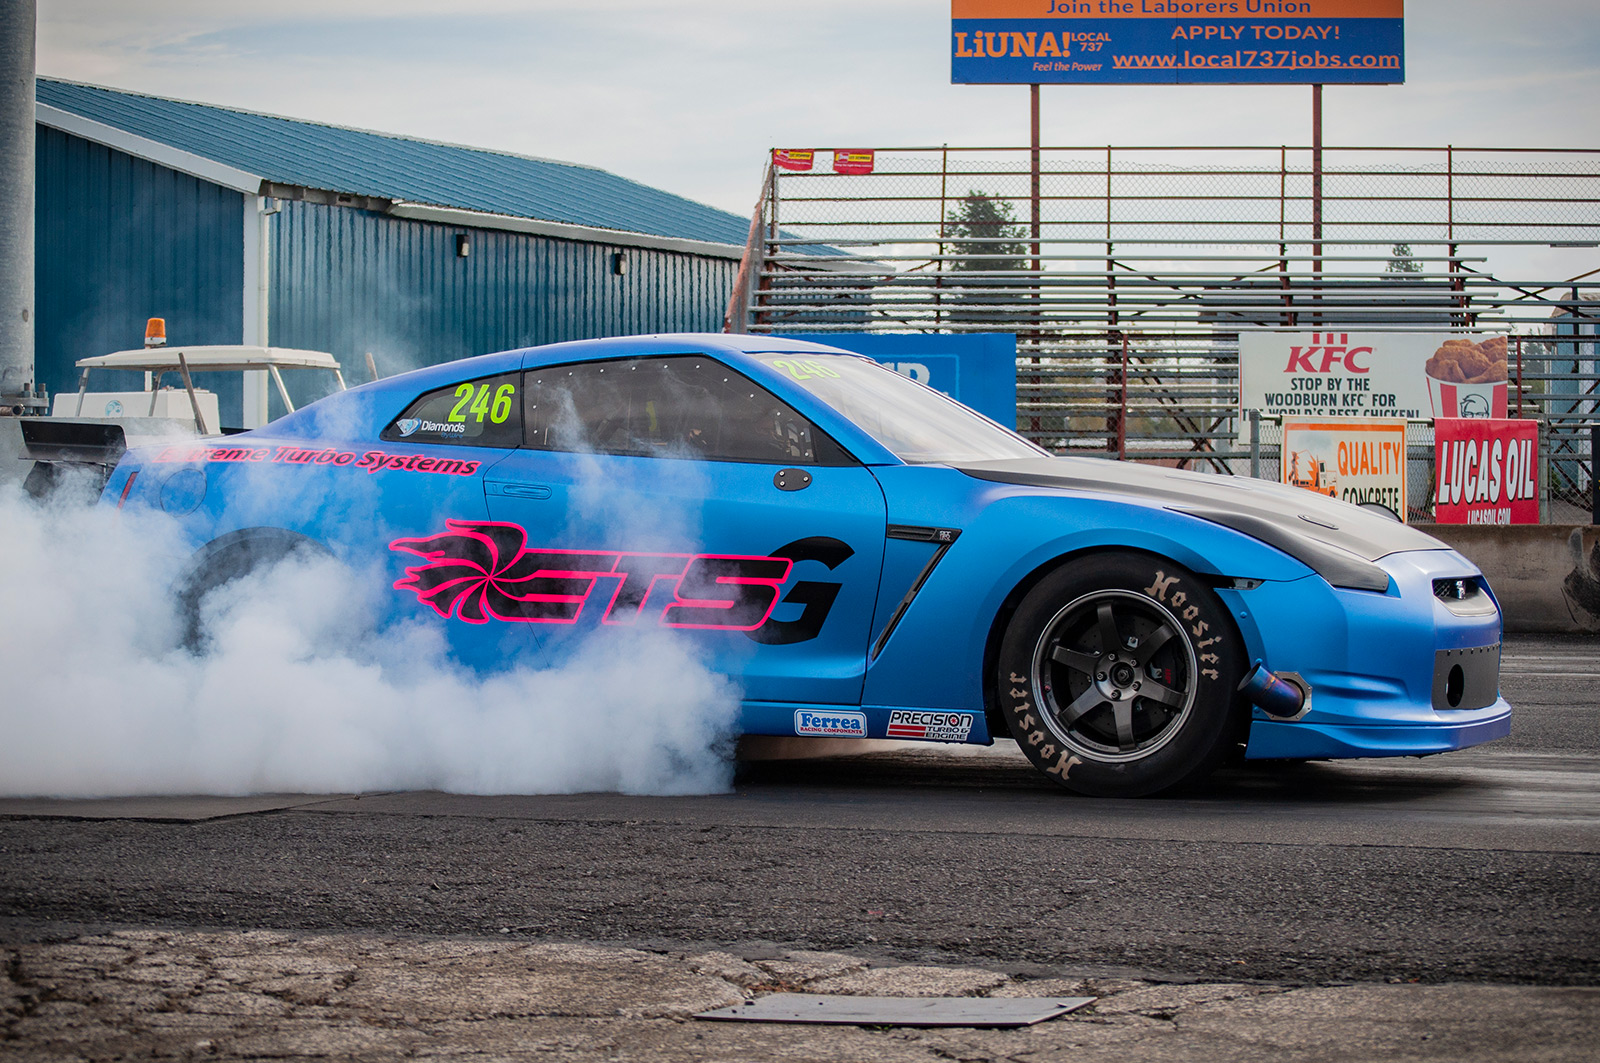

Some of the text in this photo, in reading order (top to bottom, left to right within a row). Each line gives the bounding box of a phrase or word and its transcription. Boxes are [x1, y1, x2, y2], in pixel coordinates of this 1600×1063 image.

[1046, 0, 1311, 14] Join the Laborers Union
[1071, 32, 1112, 42] LOCAL
[1171, 25, 1340, 40] APPLY TODAY!
[954, 30, 1071, 58] LiUNA!
[1080, 42, 1103, 52] 737
[1033, 62, 1102, 71] Feel the Power
[1112, 50, 1400, 70] www.local737jobs.com
[1283, 346, 1373, 374] KFC
[773, 359, 841, 380] 246
[1291, 377, 1370, 391] STOP BY THE
[447, 383, 515, 424] 246
[1265, 393, 1338, 407] WOODBURN
[1372, 394, 1396, 407] FOR
[421, 420, 466, 433] Diamonds
[271, 446, 357, 466] Turbo
[354, 450, 482, 475] Systems
[1338, 441, 1401, 477] QUALITY
[1438, 437, 1535, 506] LUCAS OIL
[1144, 570, 1222, 681] Hoosier
[801, 712, 861, 730] Ferrea
[890, 711, 974, 727] PRECISION
[1009, 671, 1083, 781] Hoosier
[927, 726, 959, 734] TURBO
